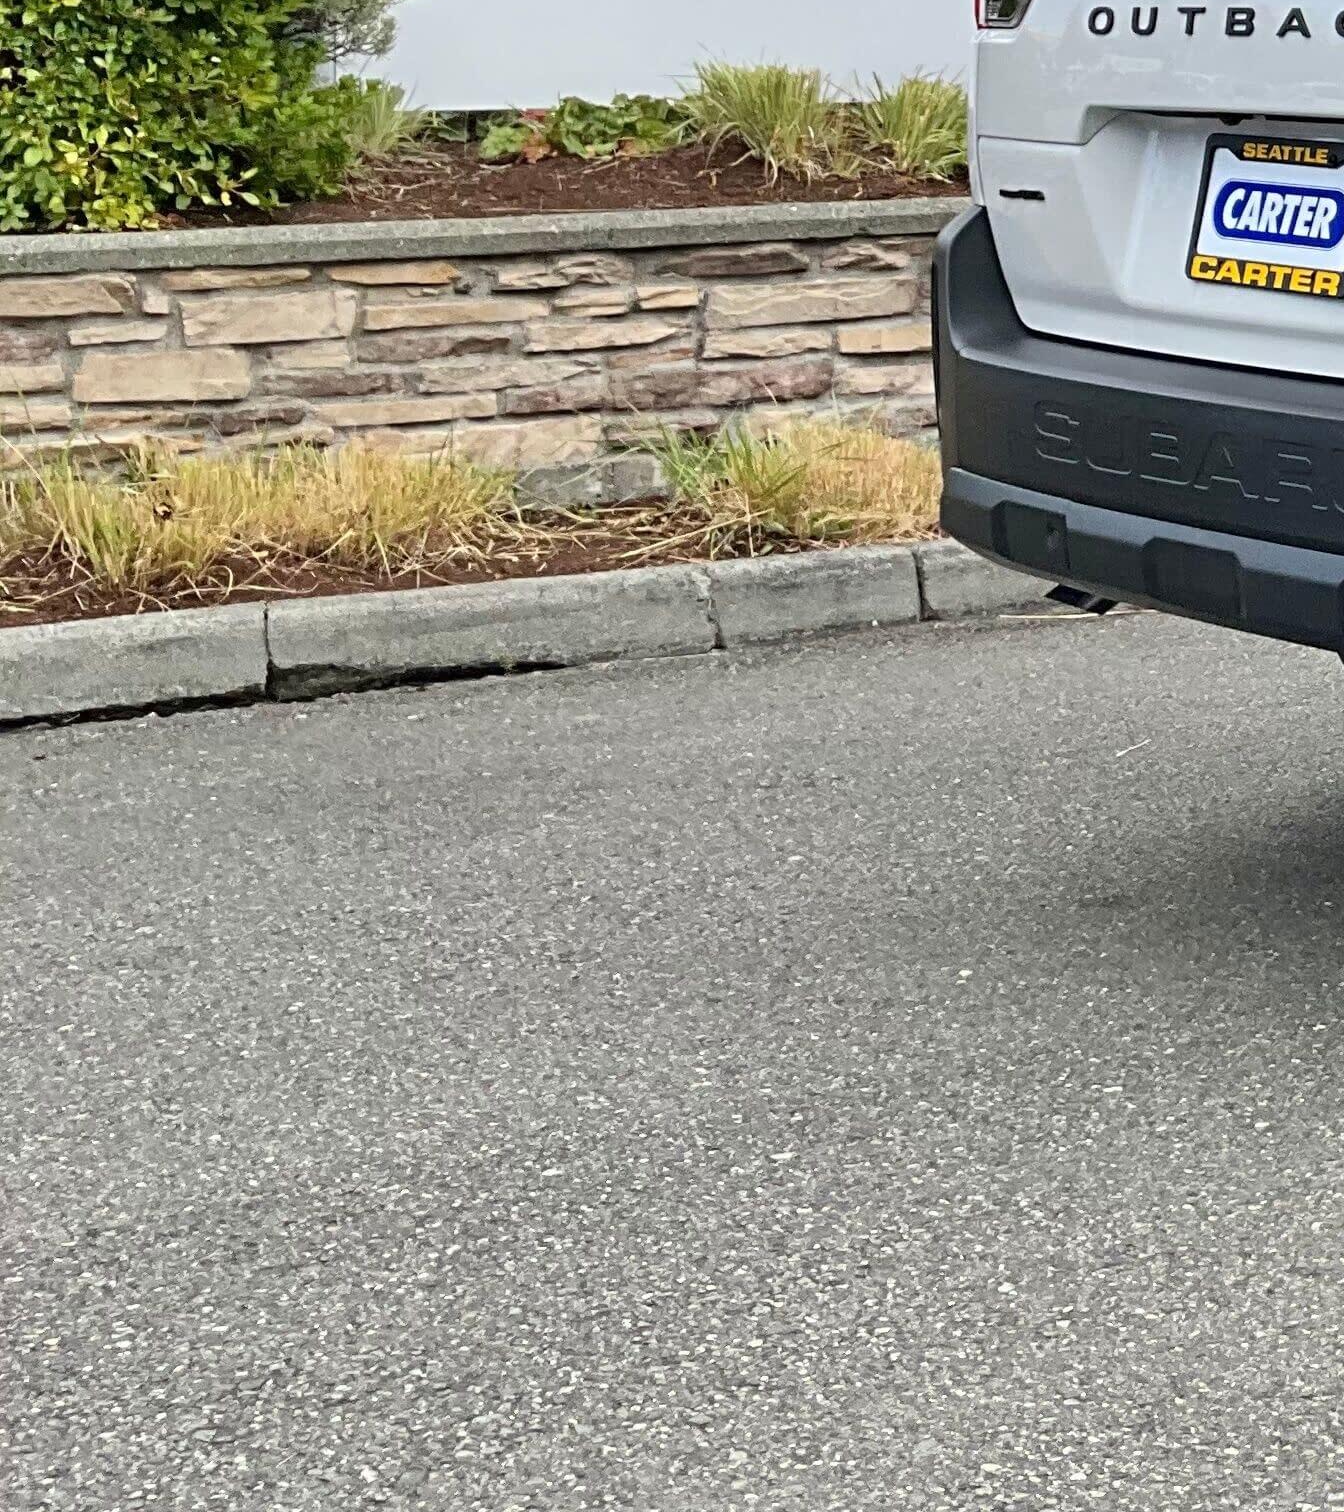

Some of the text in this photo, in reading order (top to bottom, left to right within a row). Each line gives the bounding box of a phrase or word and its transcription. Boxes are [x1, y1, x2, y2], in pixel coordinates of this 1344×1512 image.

[1242, 142, 1329, 164] SEATTLE
[1222, 188, 1338, 240] CARTER
[1190, 255, 1341, 297] CARTER
